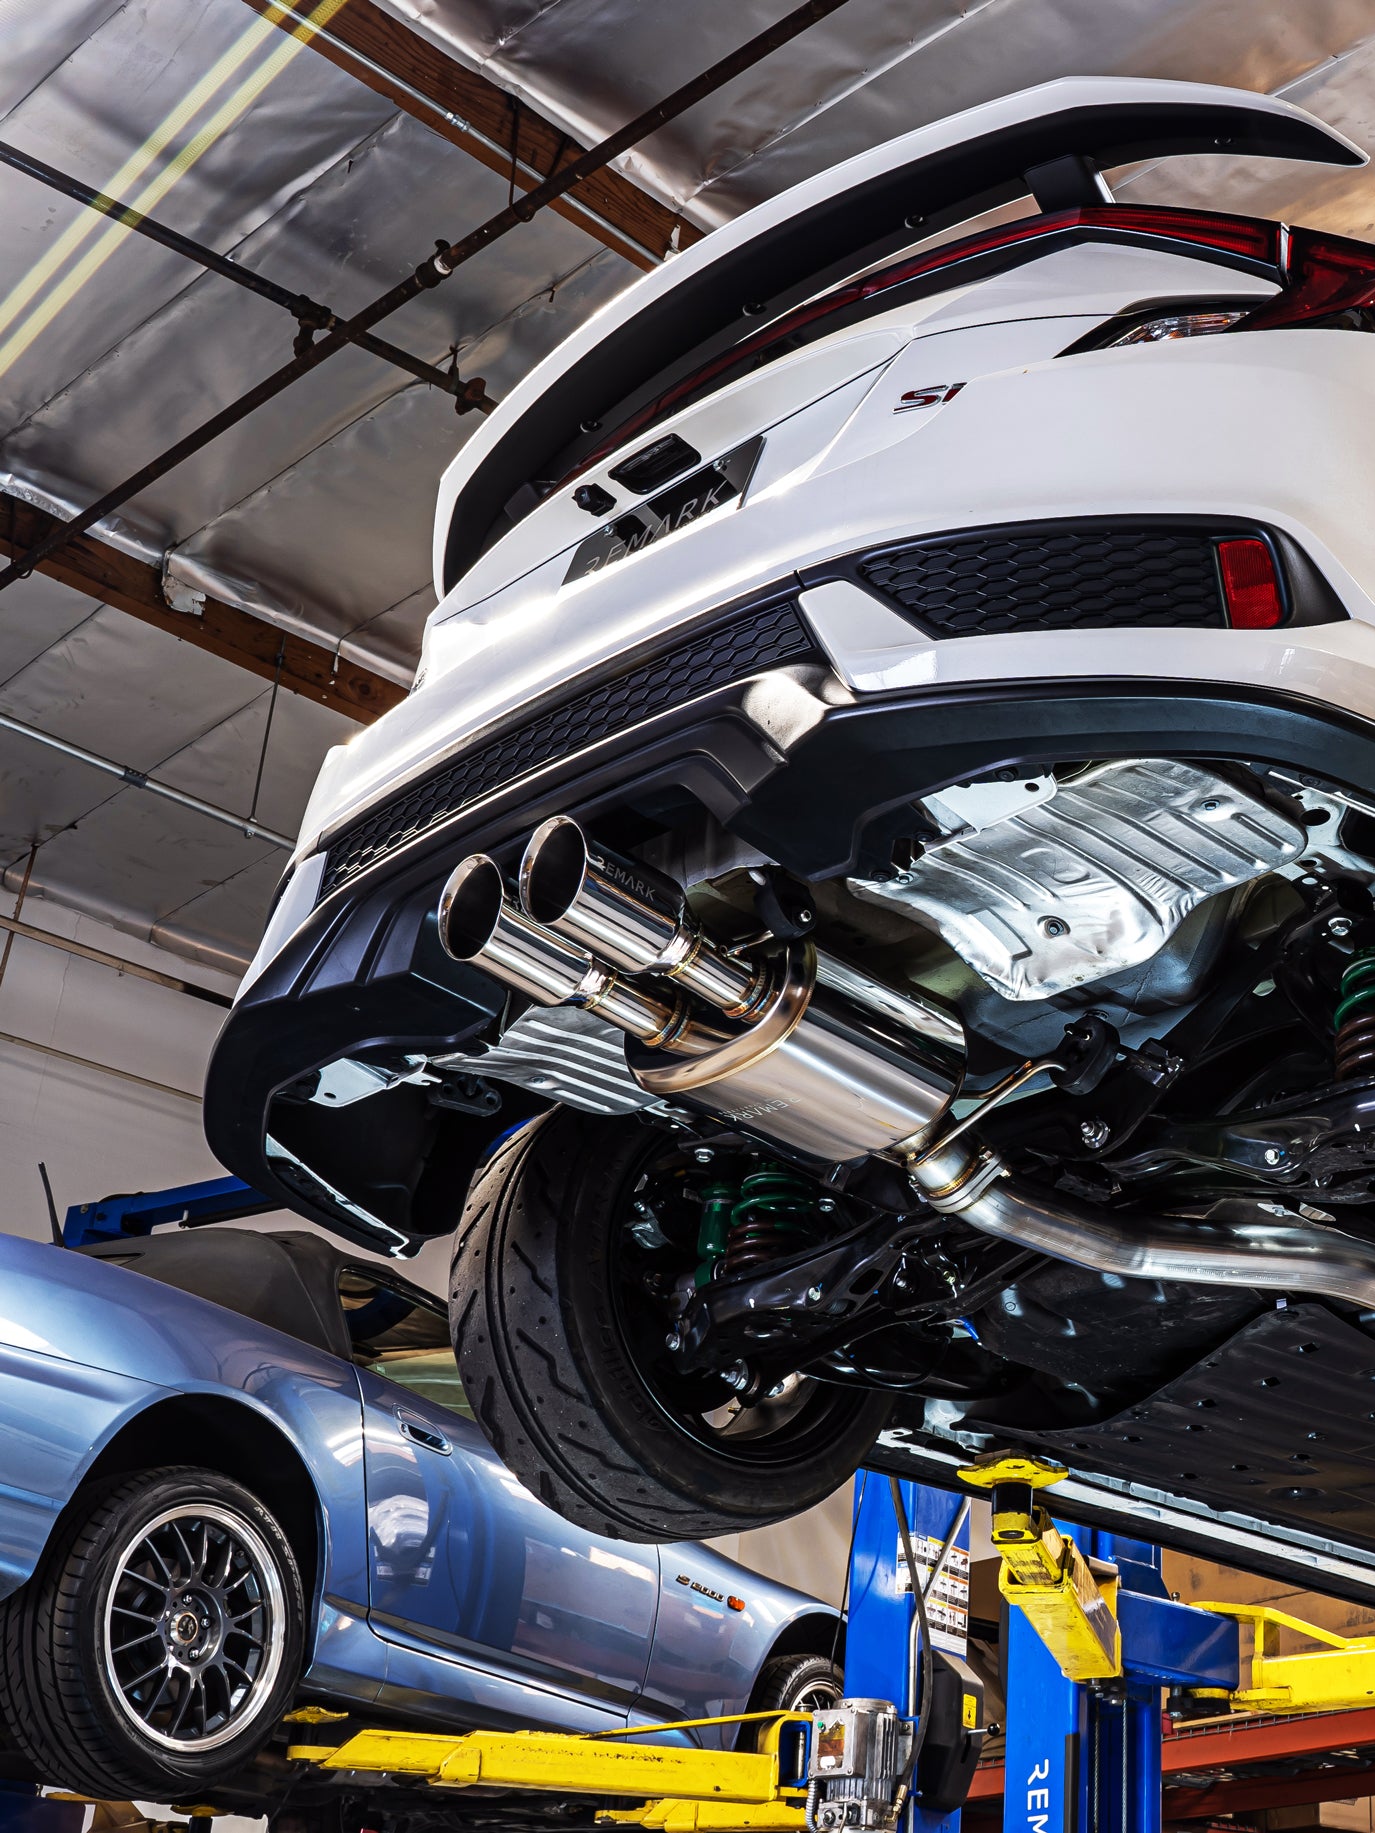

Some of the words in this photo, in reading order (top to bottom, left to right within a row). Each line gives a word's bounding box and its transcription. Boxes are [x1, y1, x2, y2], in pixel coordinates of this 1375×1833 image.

[584, 480, 728, 575] REMARK
[596, 855, 656, 901] REMARK
[723, 1097, 801, 1122] REMARK
